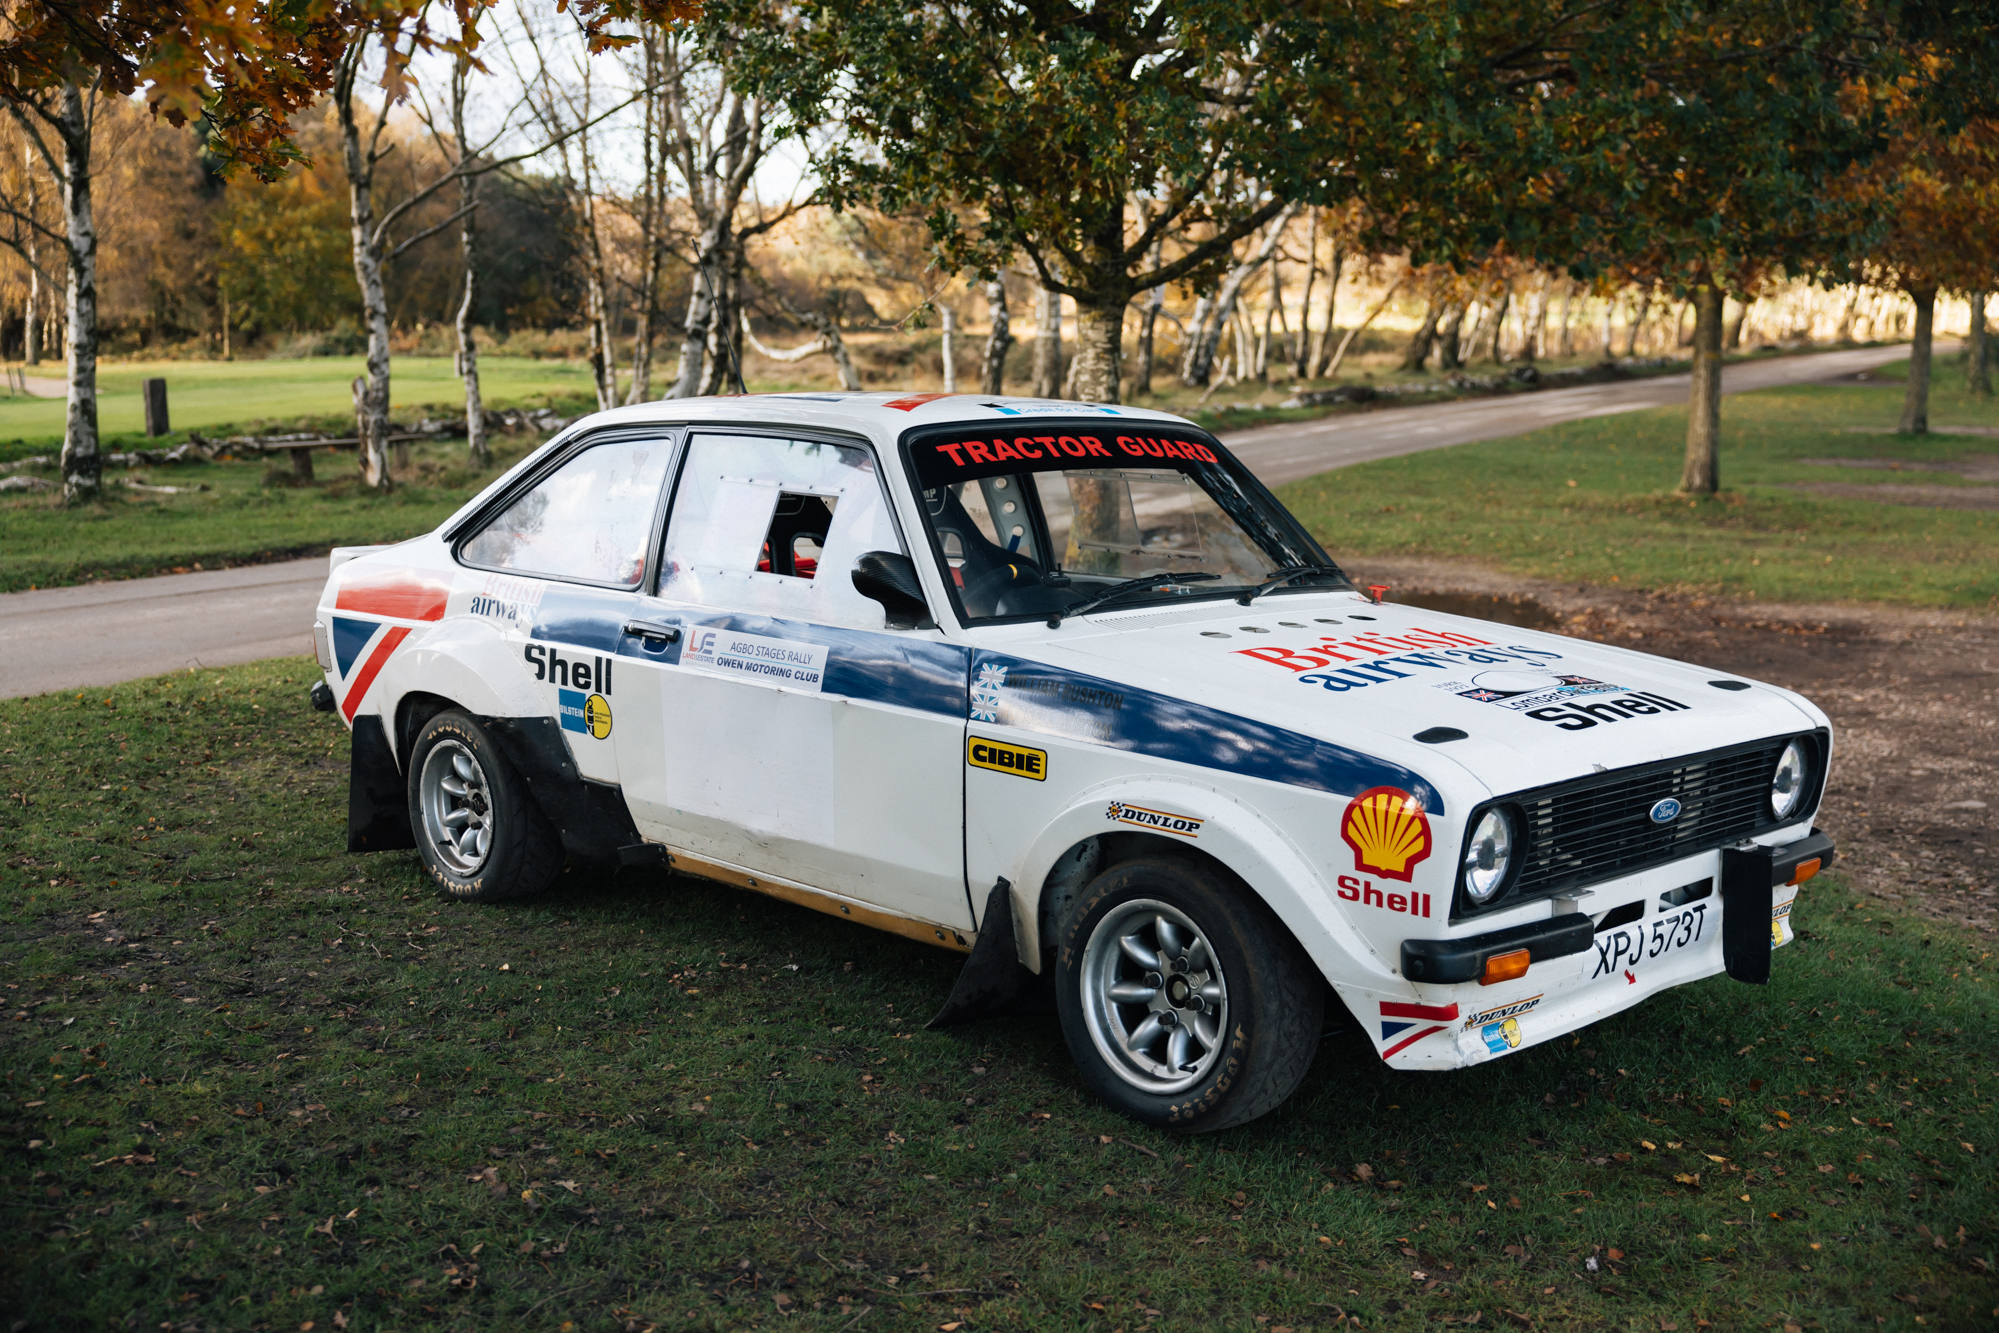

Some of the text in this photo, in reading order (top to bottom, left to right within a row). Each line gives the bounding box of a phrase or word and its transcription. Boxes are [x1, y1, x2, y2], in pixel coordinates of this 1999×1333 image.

[935, 436, 1219, 467] TRACTOR GUARD
[470, 596, 539, 629] airways
[730, 641, 813, 665] AGBO STAGES RALLY
[1228, 627, 1499, 673] British
[524, 643, 612, 696] Shell
[716, 656, 744, 670] OWEN
[744, 663, 792, 678] MOTORING
[794, 670, 819, 683] CLUB
[1298, 645, 1564, 692] airways
[1008, 672, 1124, 711] WILLIAM RUSHTON
[560, 704, 584, 718] BILSTEIN
[1525, 691, 1692, 730] Shell
[1121, 808, 1201, 832] DUNLOP
[1657, 803, 1675, 819] Ford
[1337, 874, 1431, 919] Shell
[1591, 903, 1707, 980] XPJ 573T
[1475, 998, 1541, 1026] DUNLOP
